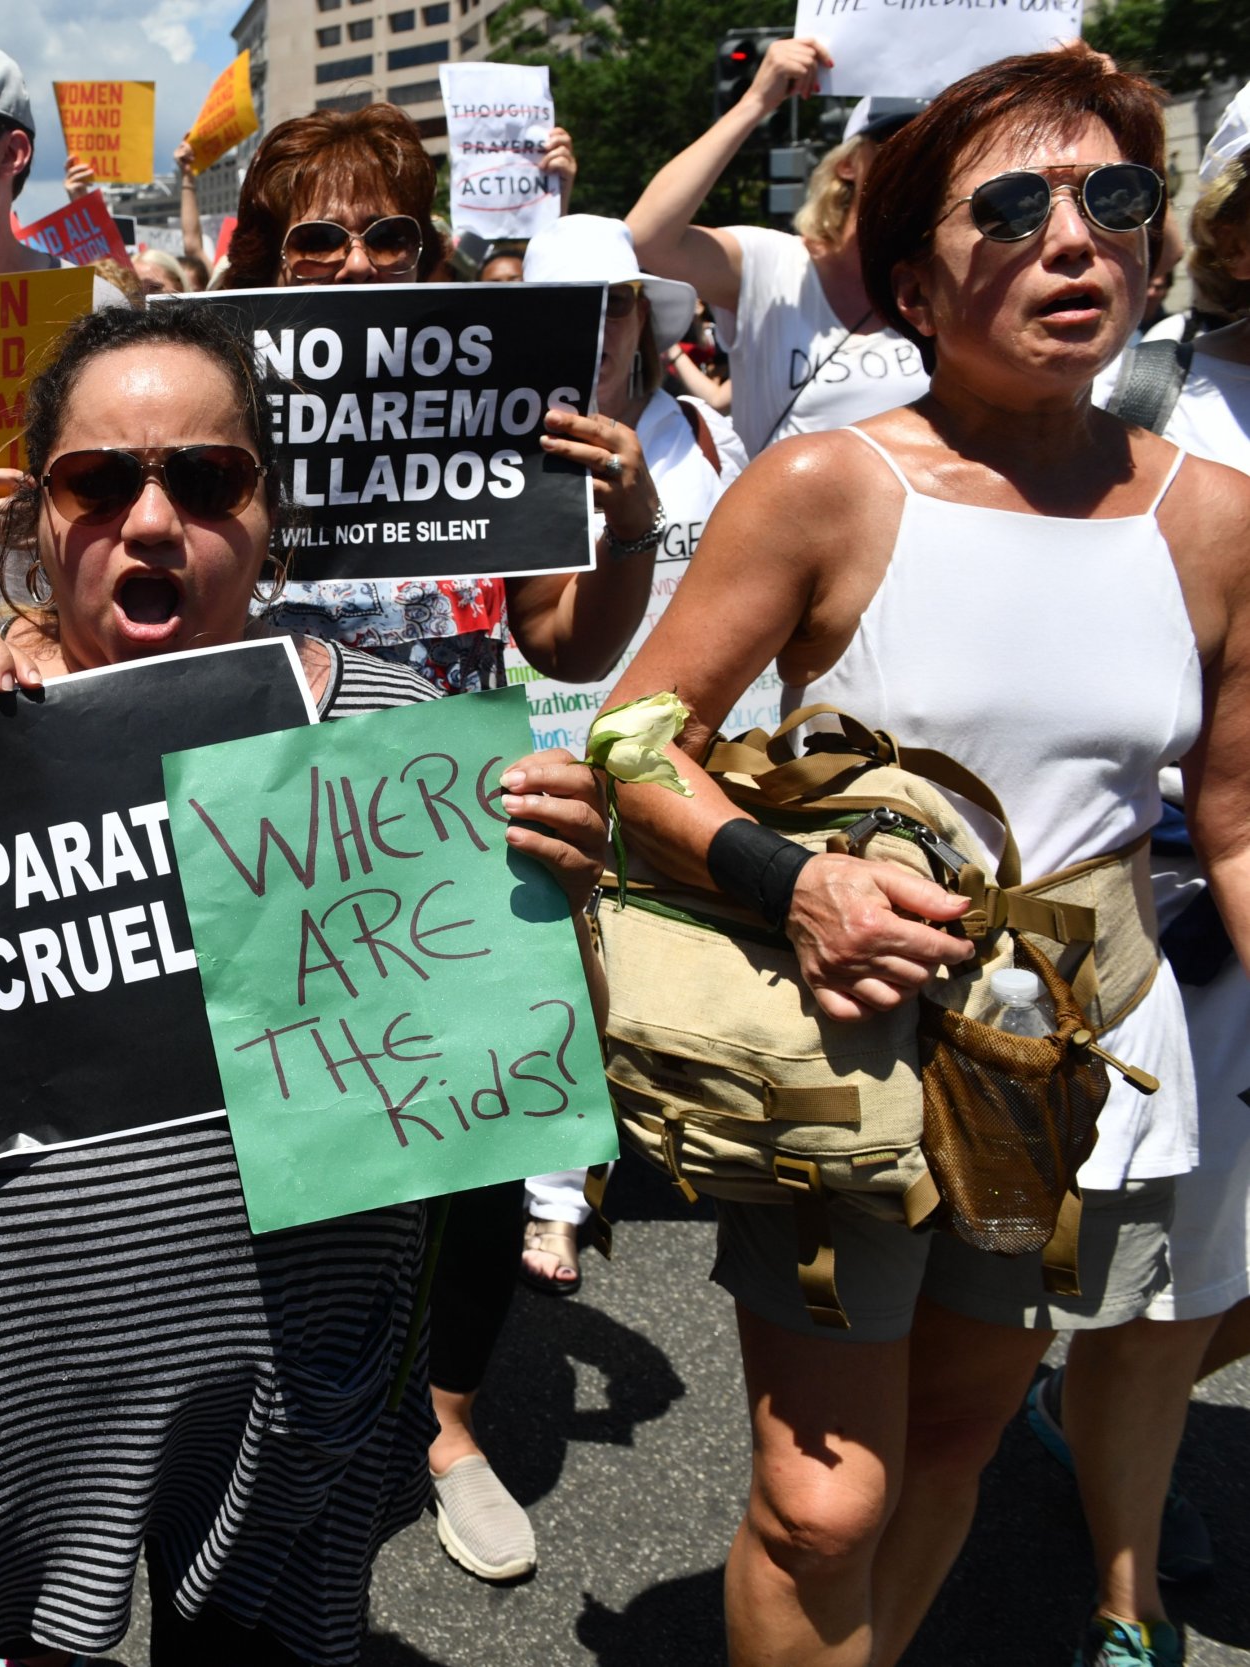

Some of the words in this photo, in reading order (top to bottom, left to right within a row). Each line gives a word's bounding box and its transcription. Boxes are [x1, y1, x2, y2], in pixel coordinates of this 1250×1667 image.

[452, 104, 550, 120] THOUGHTS
[90, 155, 121, 177] ALL
[462, 140, 547, 154] PRAYERS
[462, 175, 549, 195] ACTION
[64, 207, 101, 245] ALL
[253, 327, 343, 380] NO
[366, 325, 493, 379] NOS
[790, 345, 922, 391] DISOB
[282, 527, 330, 548] WILL
[336, 523, 377, 545] NOT
[383, 522, 411, 543] BE
[417, 519, 490, 542] SILENT
[189, 752, 512, 897] WHERE
[298, 880, 491, 1006] ARE
[234, 1012, 443, 1100] THE
